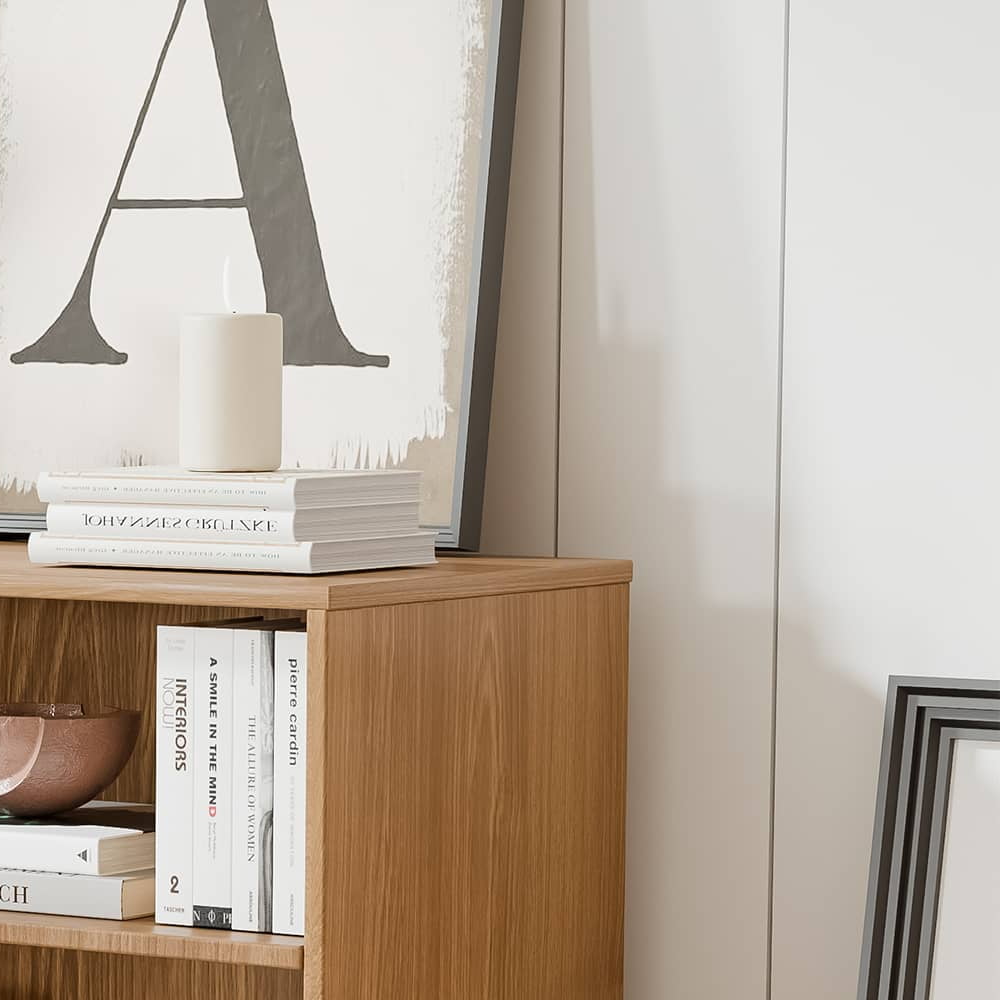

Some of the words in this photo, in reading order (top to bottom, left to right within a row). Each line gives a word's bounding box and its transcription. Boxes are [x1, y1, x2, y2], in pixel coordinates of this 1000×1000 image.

[10, 0, 390, 367] A
[209, 657, 218, 667] A
[287, 659, 300, 708] pierre
[209, 673, 218, 718] SMILE
[175, 678, 187, 772] INTERIORS
[209, 724, 217, 739] IN
[248, 716, 256, 741] THE
[289, 713, 299, 766] cardin
[208, 742, 217, 771] THE
[247, 744, 256, 790] ALLURE
[208, 777, 217, 818] MIND
[247, 815, 256, 863] WOMEN
[170, 875, 179, 894] 2
